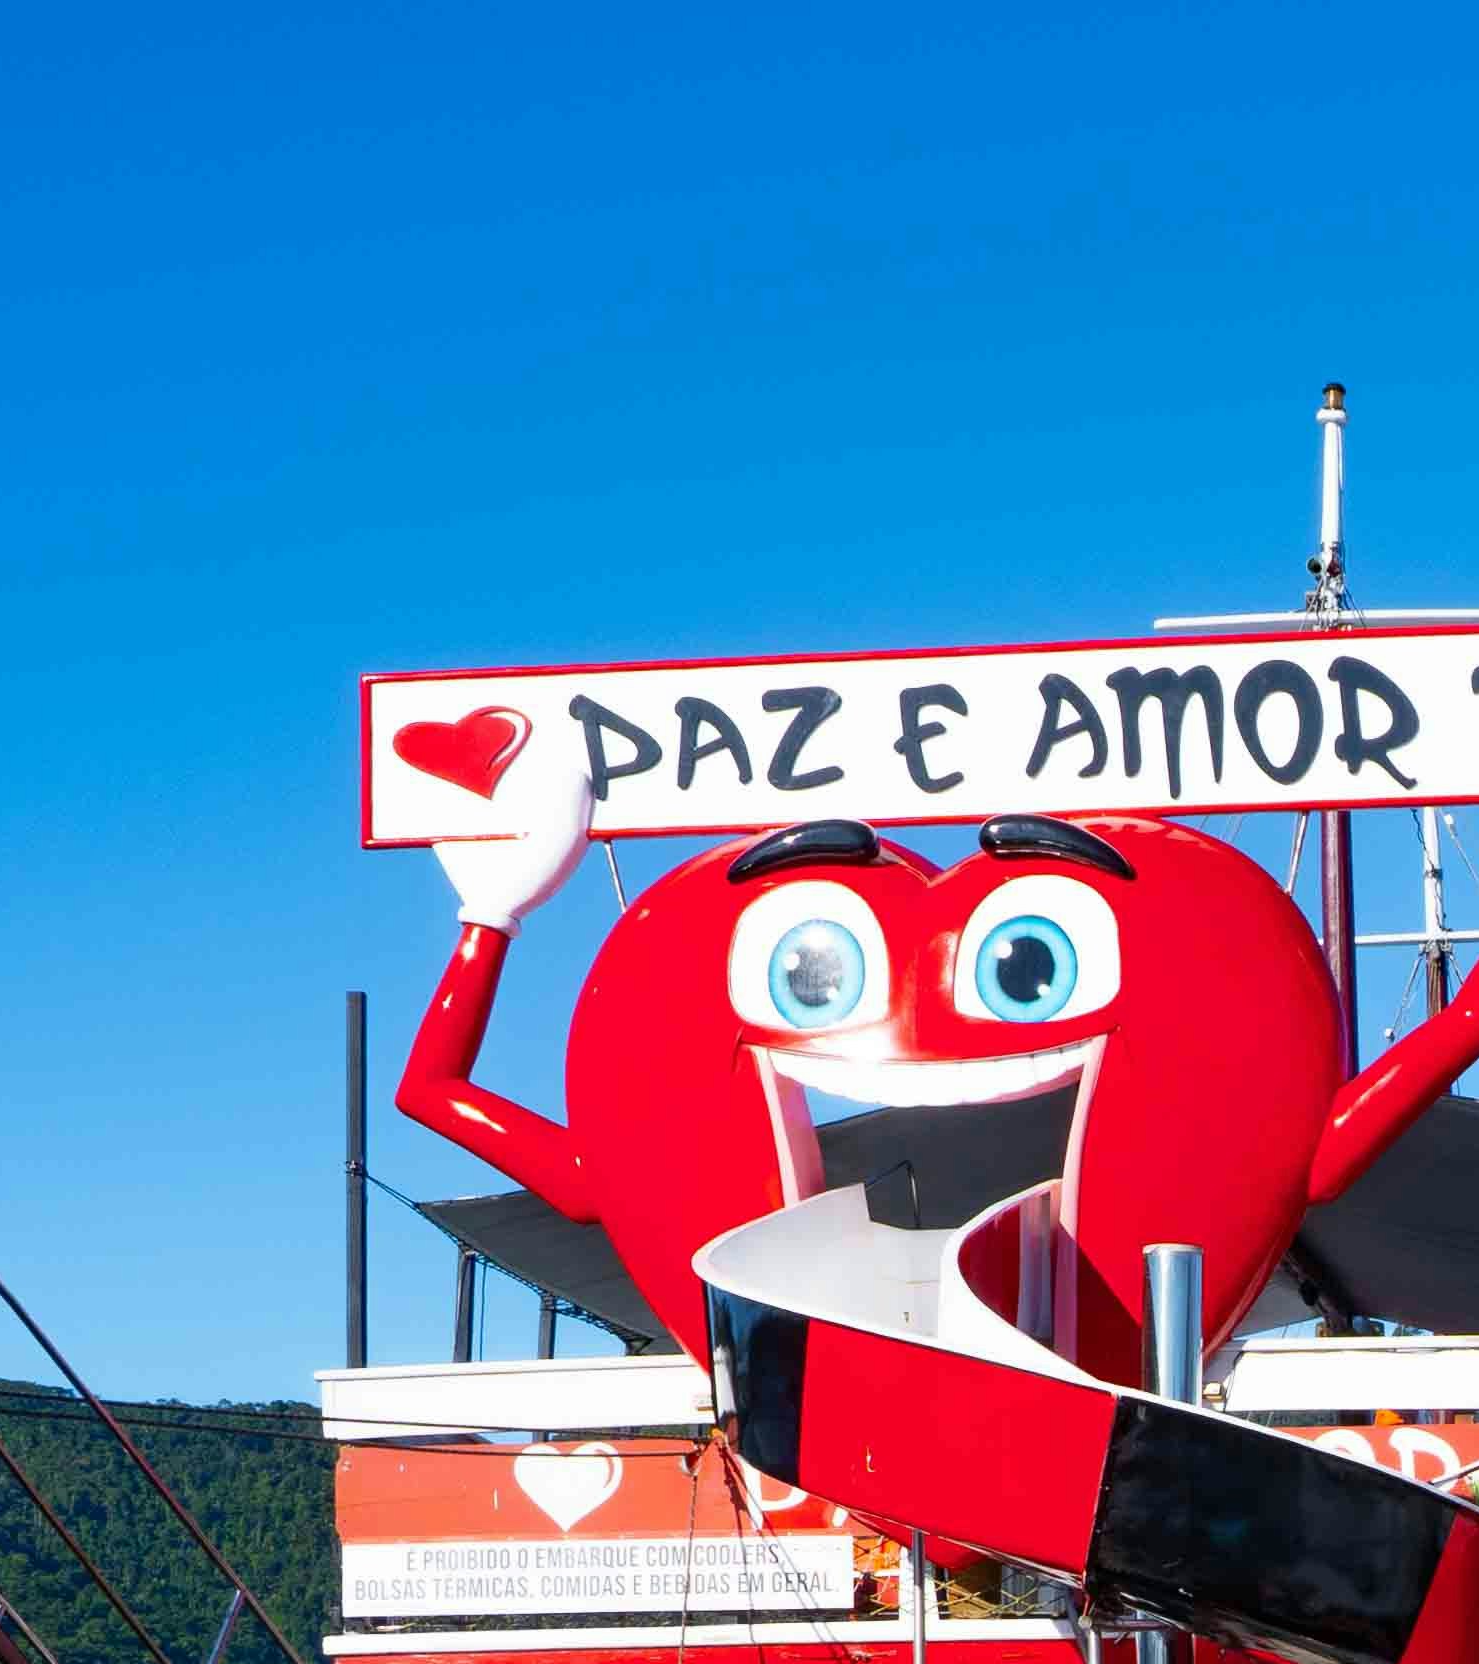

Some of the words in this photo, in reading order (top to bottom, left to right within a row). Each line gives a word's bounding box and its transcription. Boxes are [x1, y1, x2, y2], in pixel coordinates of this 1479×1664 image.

[568, 686, 845, 801] PAZ
[893, 683, 969, 793] E
[1025, 655, 1421, 801] AMOR
[423, 1548, 511, 1571] PROIBIDO
[517, 1548, 529, 1569] O
[536, 1545, 641, 1568] EMBARQUE
[646, 1545, 687, 1567] COM
[355, 1578, 426, 1600] BOLSAS
[541, 1575, 626, 1598] COMIDAS
[633, 1575, 642, 1595] E
[650, 1573, 730, 1596] BEBIDAS
[738, 1572, 764, 1594] EM
